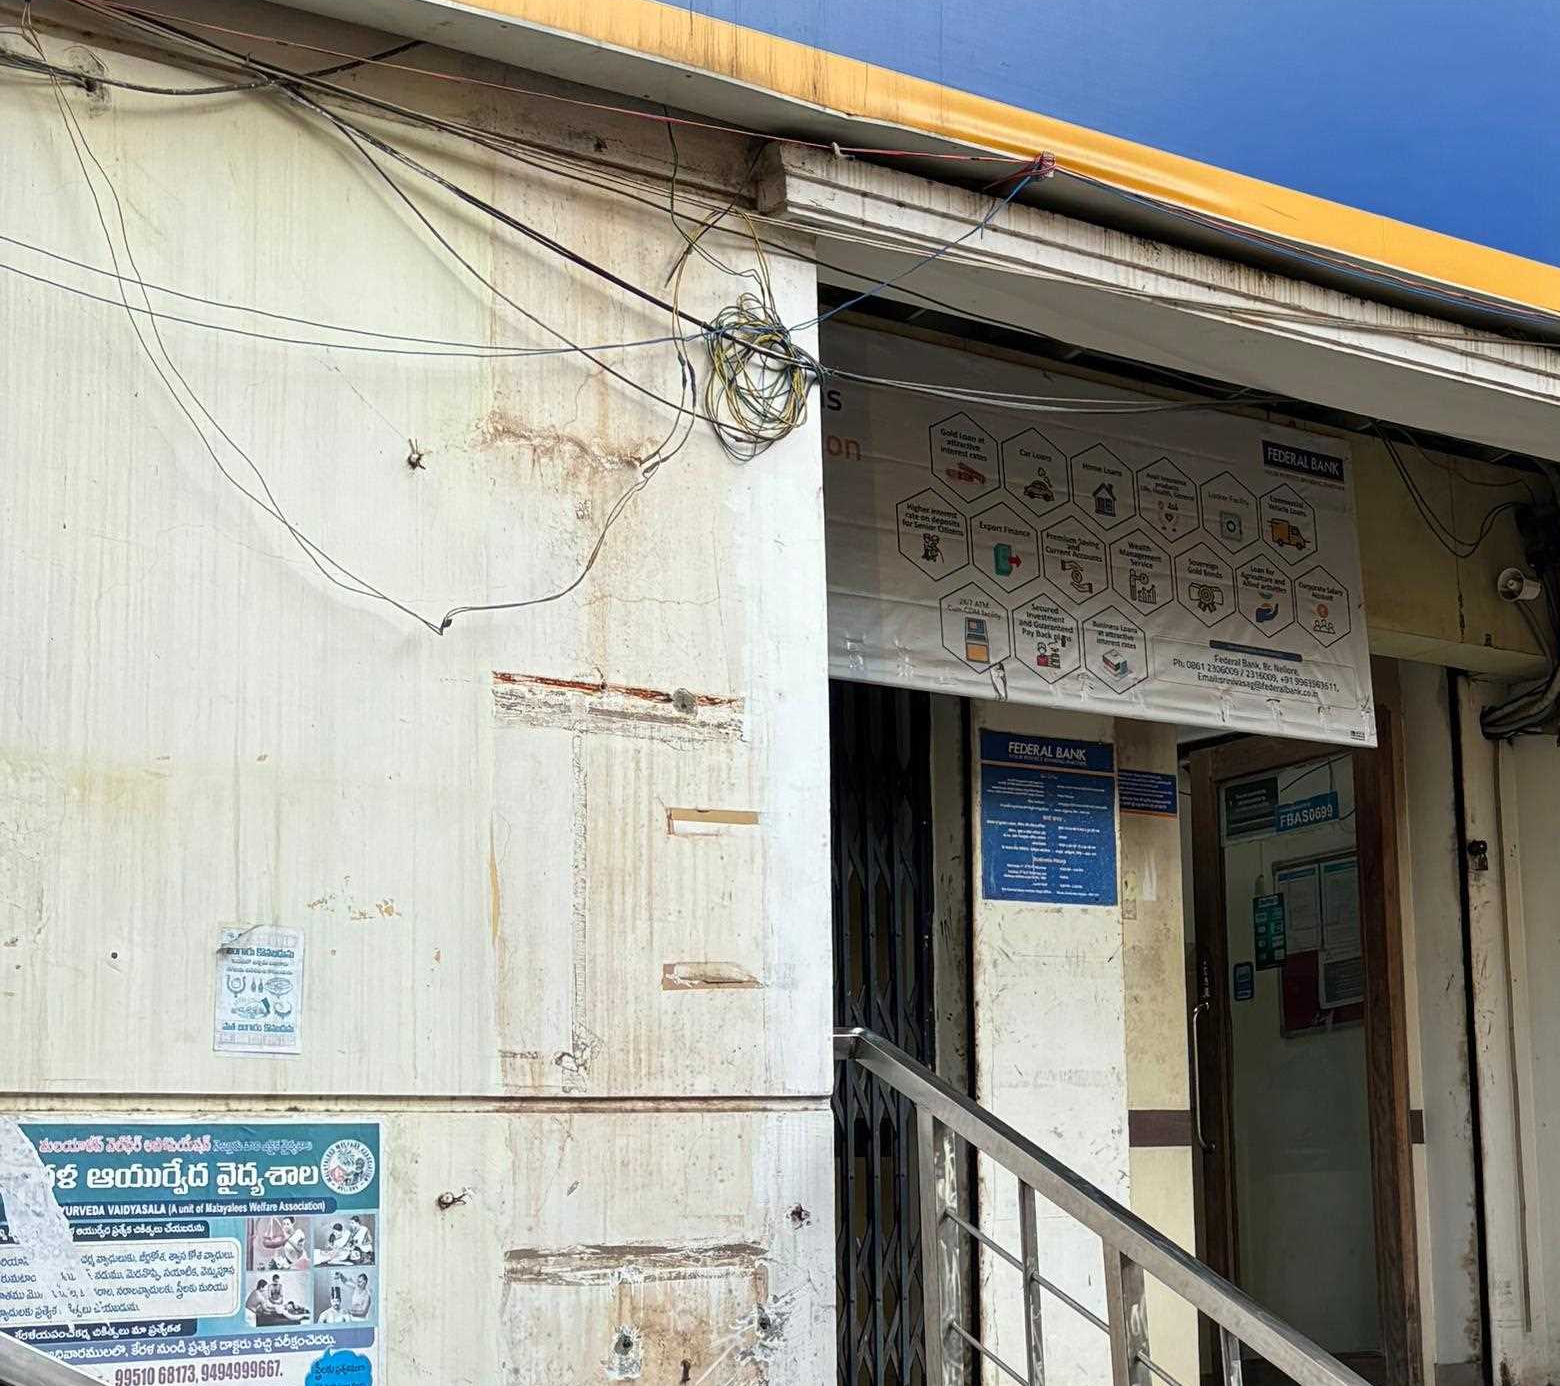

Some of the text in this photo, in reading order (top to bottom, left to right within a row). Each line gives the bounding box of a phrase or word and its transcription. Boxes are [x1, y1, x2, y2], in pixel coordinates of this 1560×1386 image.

[1267, 447, 1340, 476] FEDERAL BANK
[1214, 655, 1241, 667] Federal
[1008, 741, 1054, 758] FEDERAL
[1056, 748, 1087, 761] BANK
[108, 1204, 167, 1216] VAIDYASALA
[179, 1203, 194, 1214] unit
[249, 1201, 277, 1213] Welfare
[279, 1200, 326, 1213] Association)
[158, 1364, 199, 1385] 68173,
[201, 1359, 283, 1382] 9494999667.
